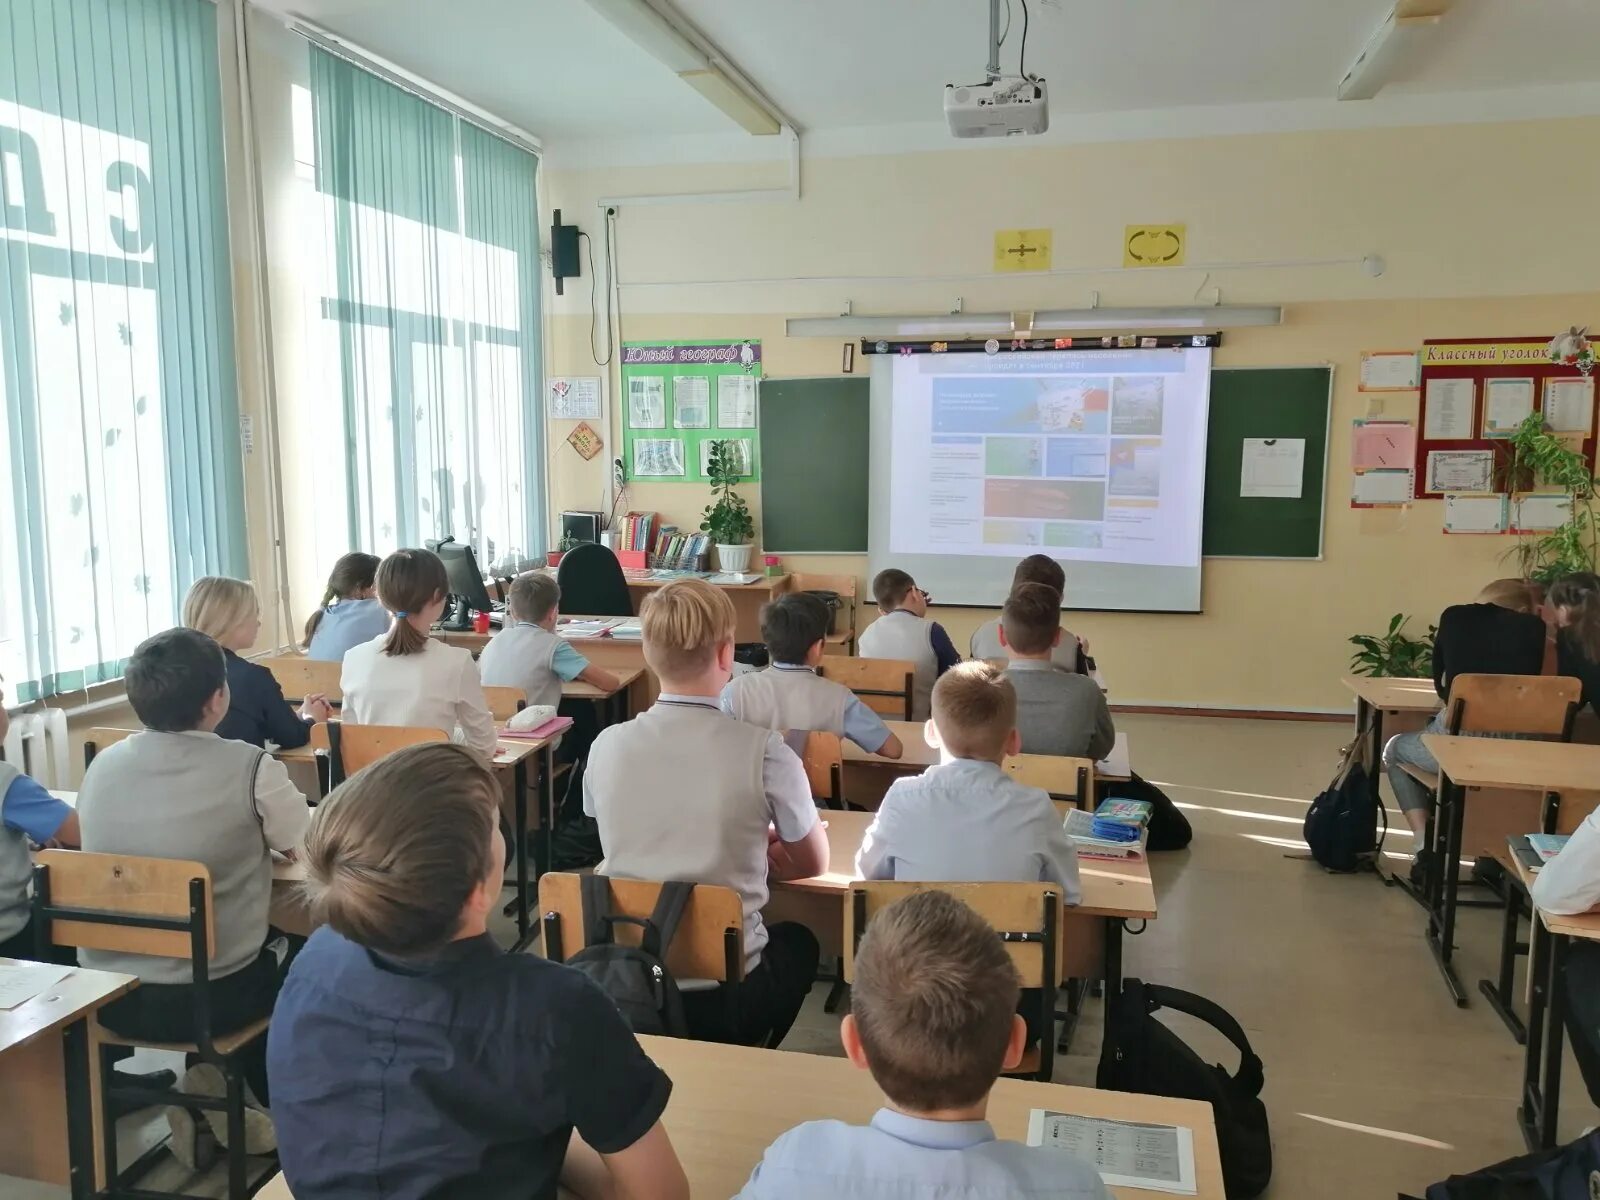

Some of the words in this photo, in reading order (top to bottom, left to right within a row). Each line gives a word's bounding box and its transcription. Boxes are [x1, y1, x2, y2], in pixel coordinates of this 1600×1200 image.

[624, 345, 675, 362] Юный
[679, 343, 739, 365] географ
[1427, 345, 1496, 361] Классный
[1501, 348, 1550, 363] уголок
